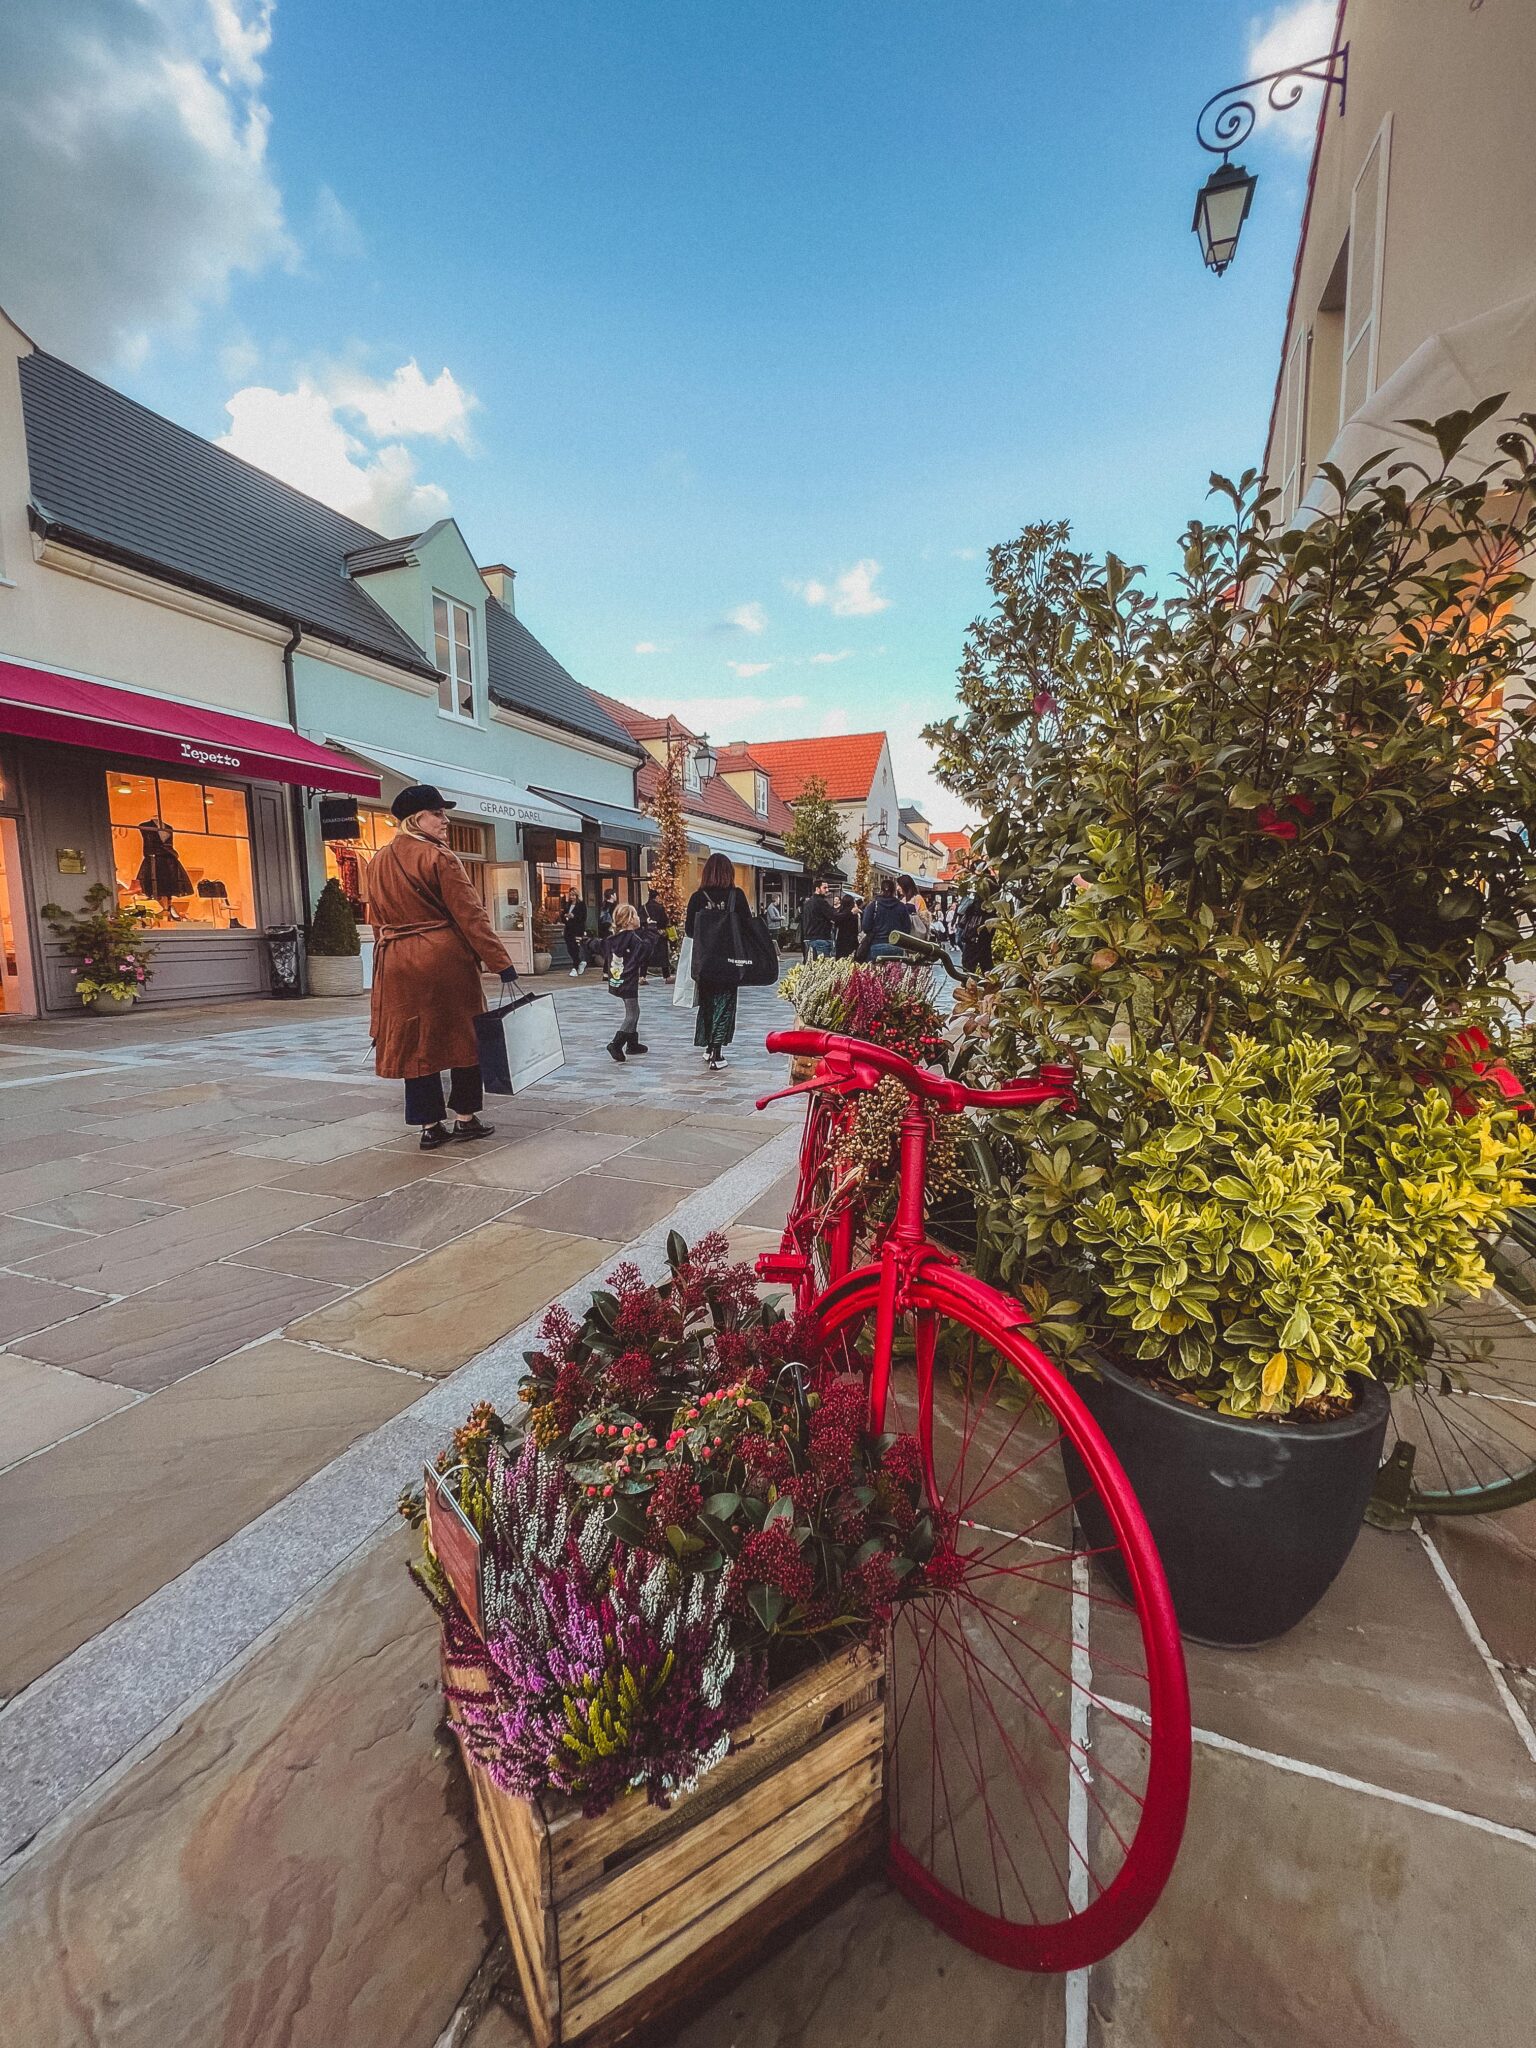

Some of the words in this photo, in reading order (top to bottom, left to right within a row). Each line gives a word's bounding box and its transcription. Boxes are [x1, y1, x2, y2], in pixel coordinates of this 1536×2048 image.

[180, 743, 241, 767] repetto
[479, 801, 516, 817] GERARD
[517, 809, 543, 822] DAREL
